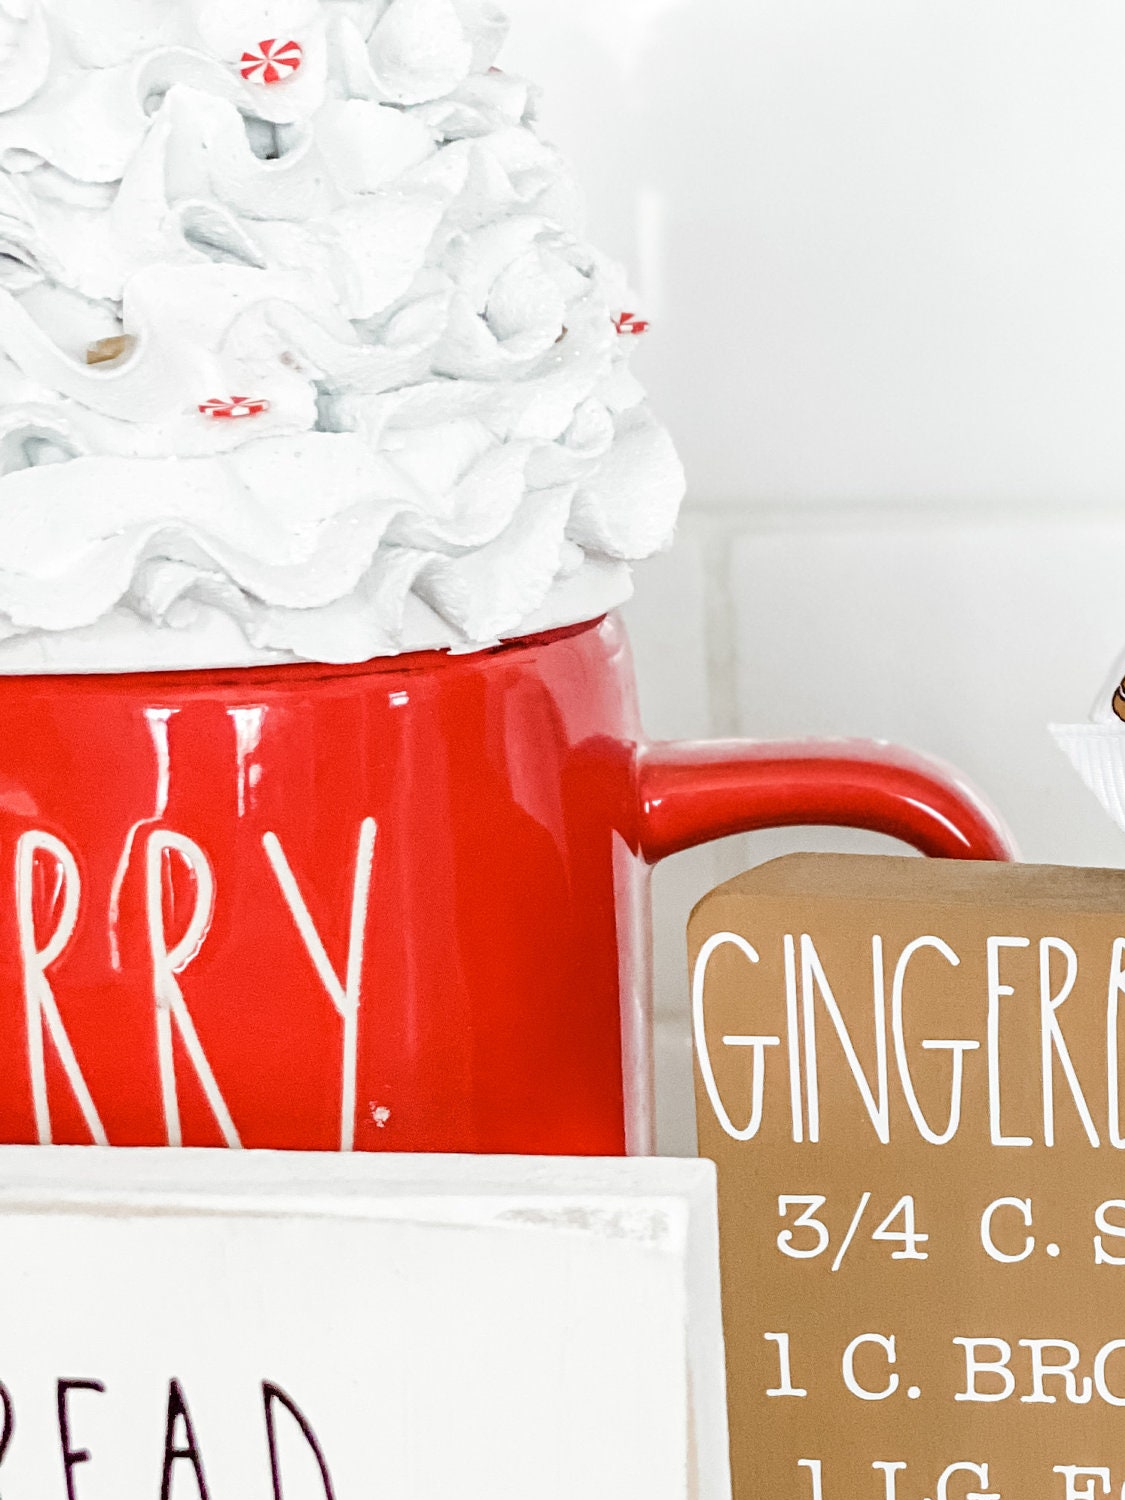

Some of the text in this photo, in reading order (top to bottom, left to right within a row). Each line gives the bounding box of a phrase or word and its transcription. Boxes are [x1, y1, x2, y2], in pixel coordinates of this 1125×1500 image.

[778, 1194, 929, 1272] 3/4
[982, 1198, 1060, 1263] C.
[766, 1334, 807, 1397] 1
[844, 1335, 921, 1401] C.
